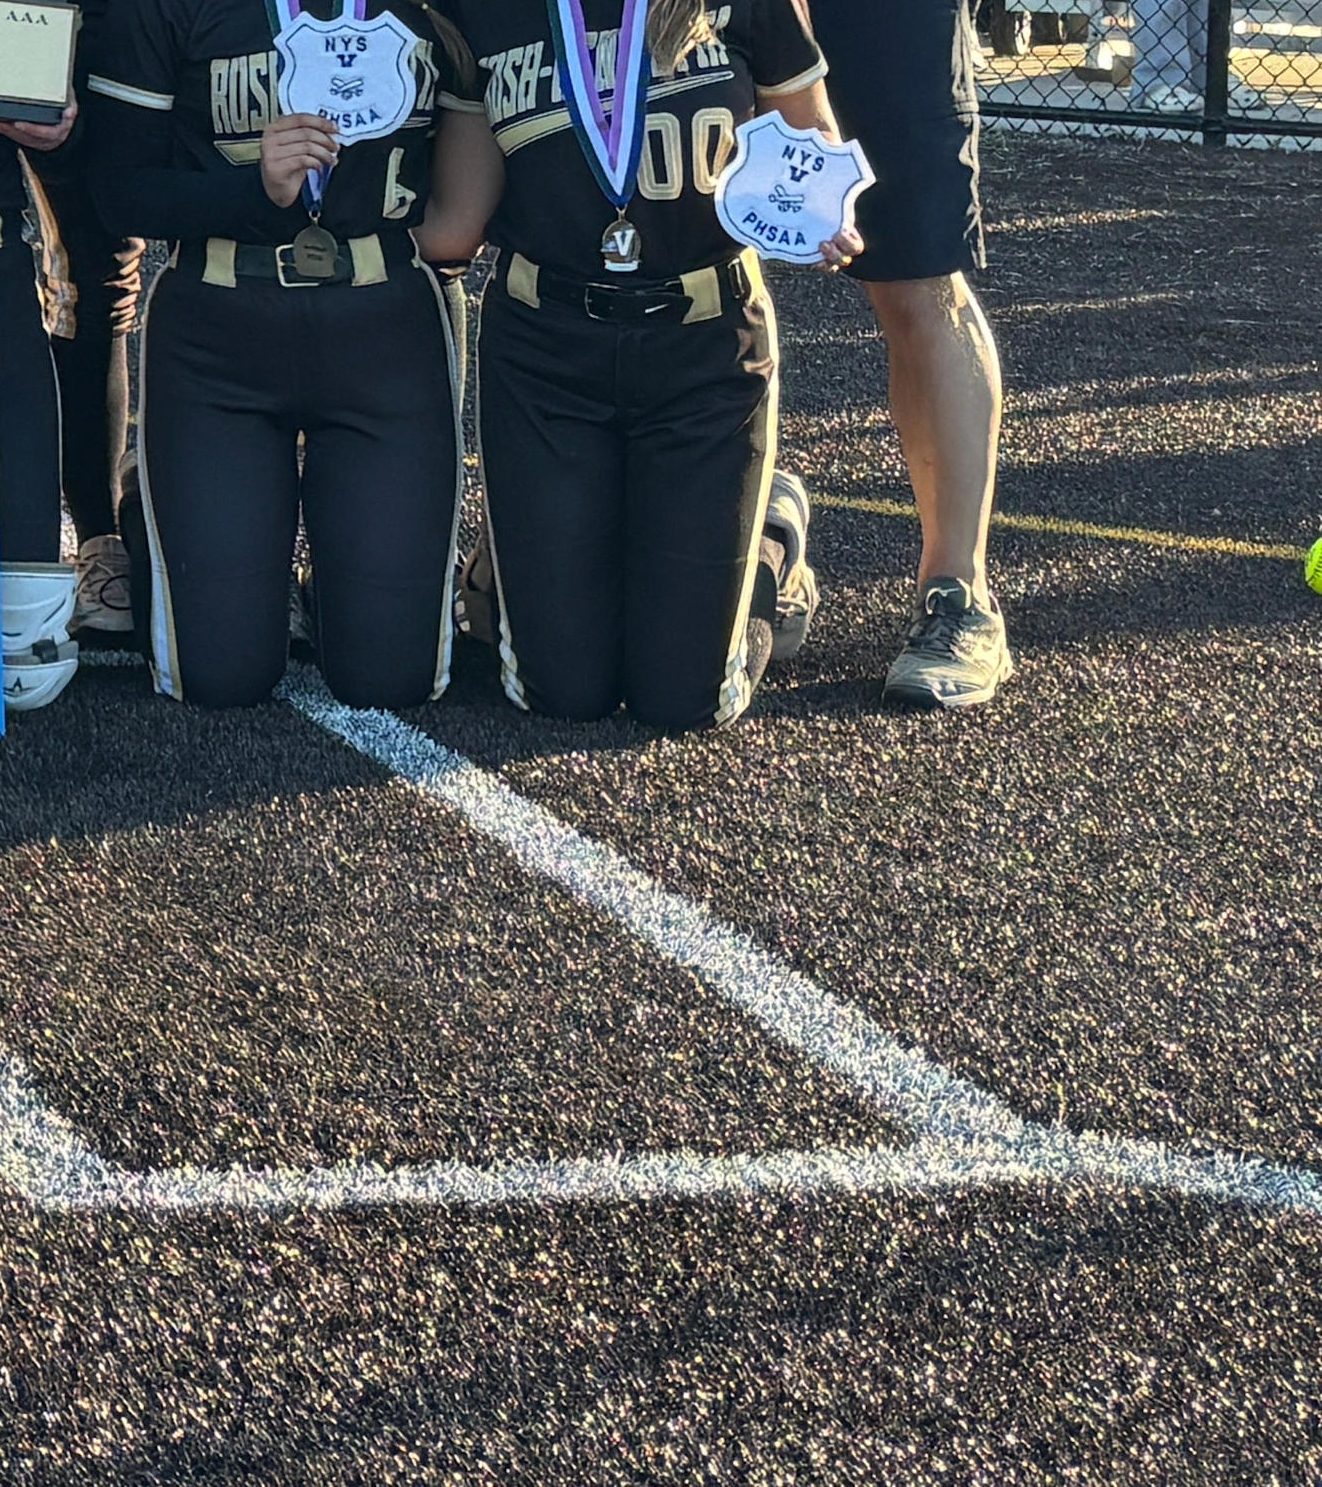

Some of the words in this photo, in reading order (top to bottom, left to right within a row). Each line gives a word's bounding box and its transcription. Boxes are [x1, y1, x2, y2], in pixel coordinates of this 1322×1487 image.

[6, 9, 49, 26] AAA
[325, 36, 367, 52] NYS
[638, 107, 734, 201] 00
[781, 144, 825, 173] NYS
[742, 211, 807, 246] PHSAA
